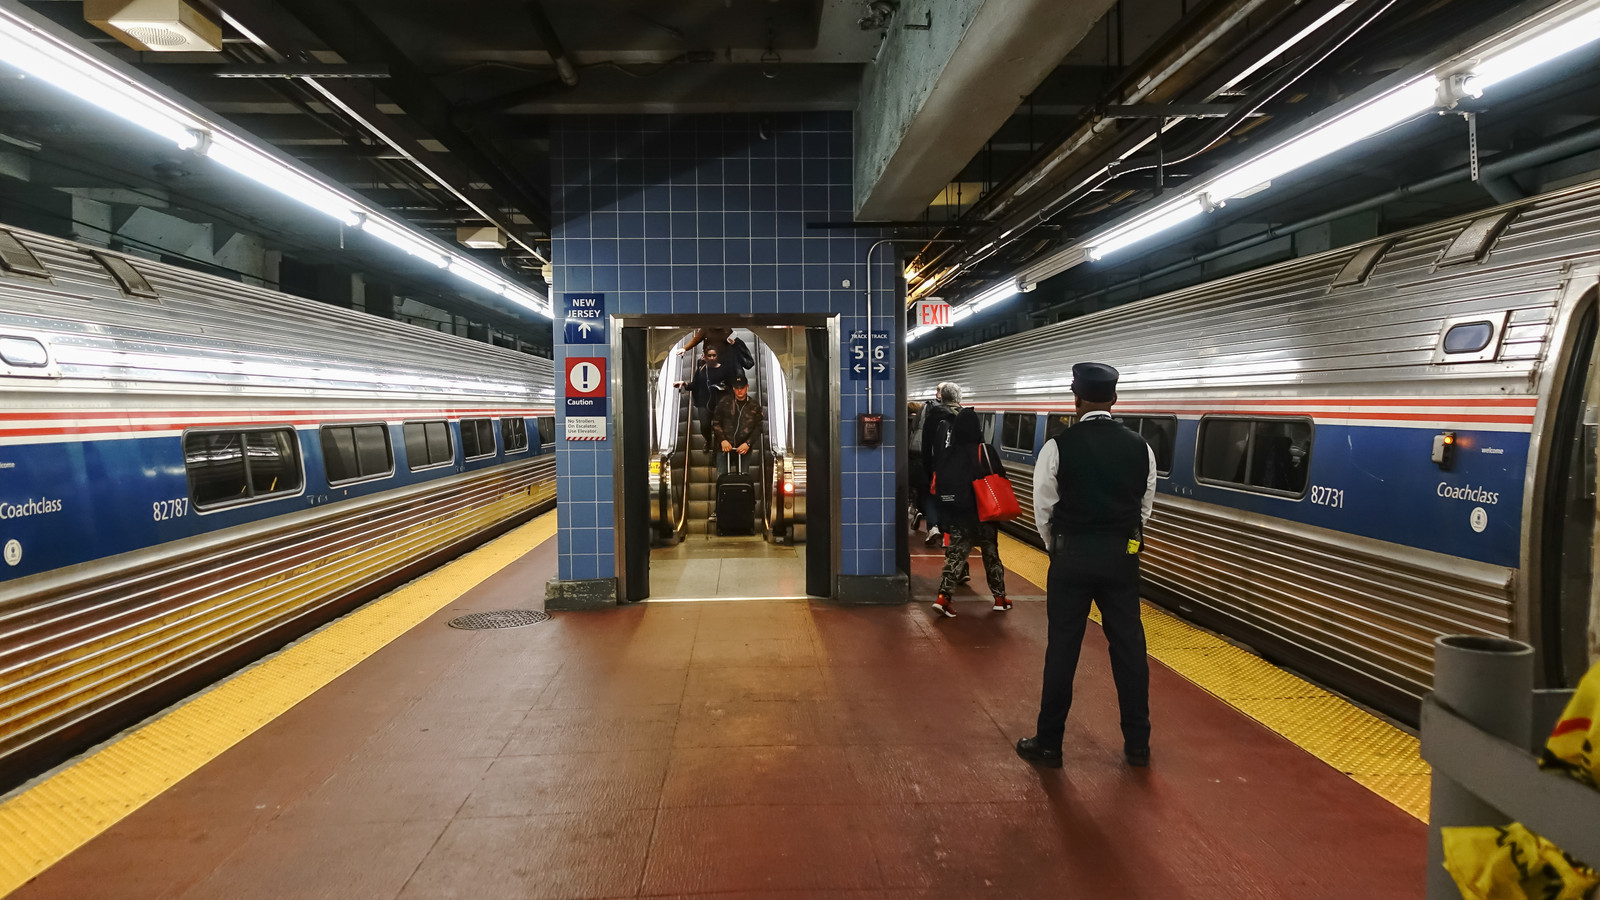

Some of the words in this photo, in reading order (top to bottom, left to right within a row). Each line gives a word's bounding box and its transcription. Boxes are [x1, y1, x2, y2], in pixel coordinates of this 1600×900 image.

[572, 298, 596, 307] NEW
[567, 309, 601, 318] JERSEY
[922, 304, 950, 325] EXIT
[854, 345, 864, 360] 5
[874, 345, 885, 360] 6
[1311, 485, 1344, 508] 82731
[1437, 482, 1499, 505] Coachclass
[0, 497, 62, 520] Coachclass
[153, 498, 188, 521] 82787
